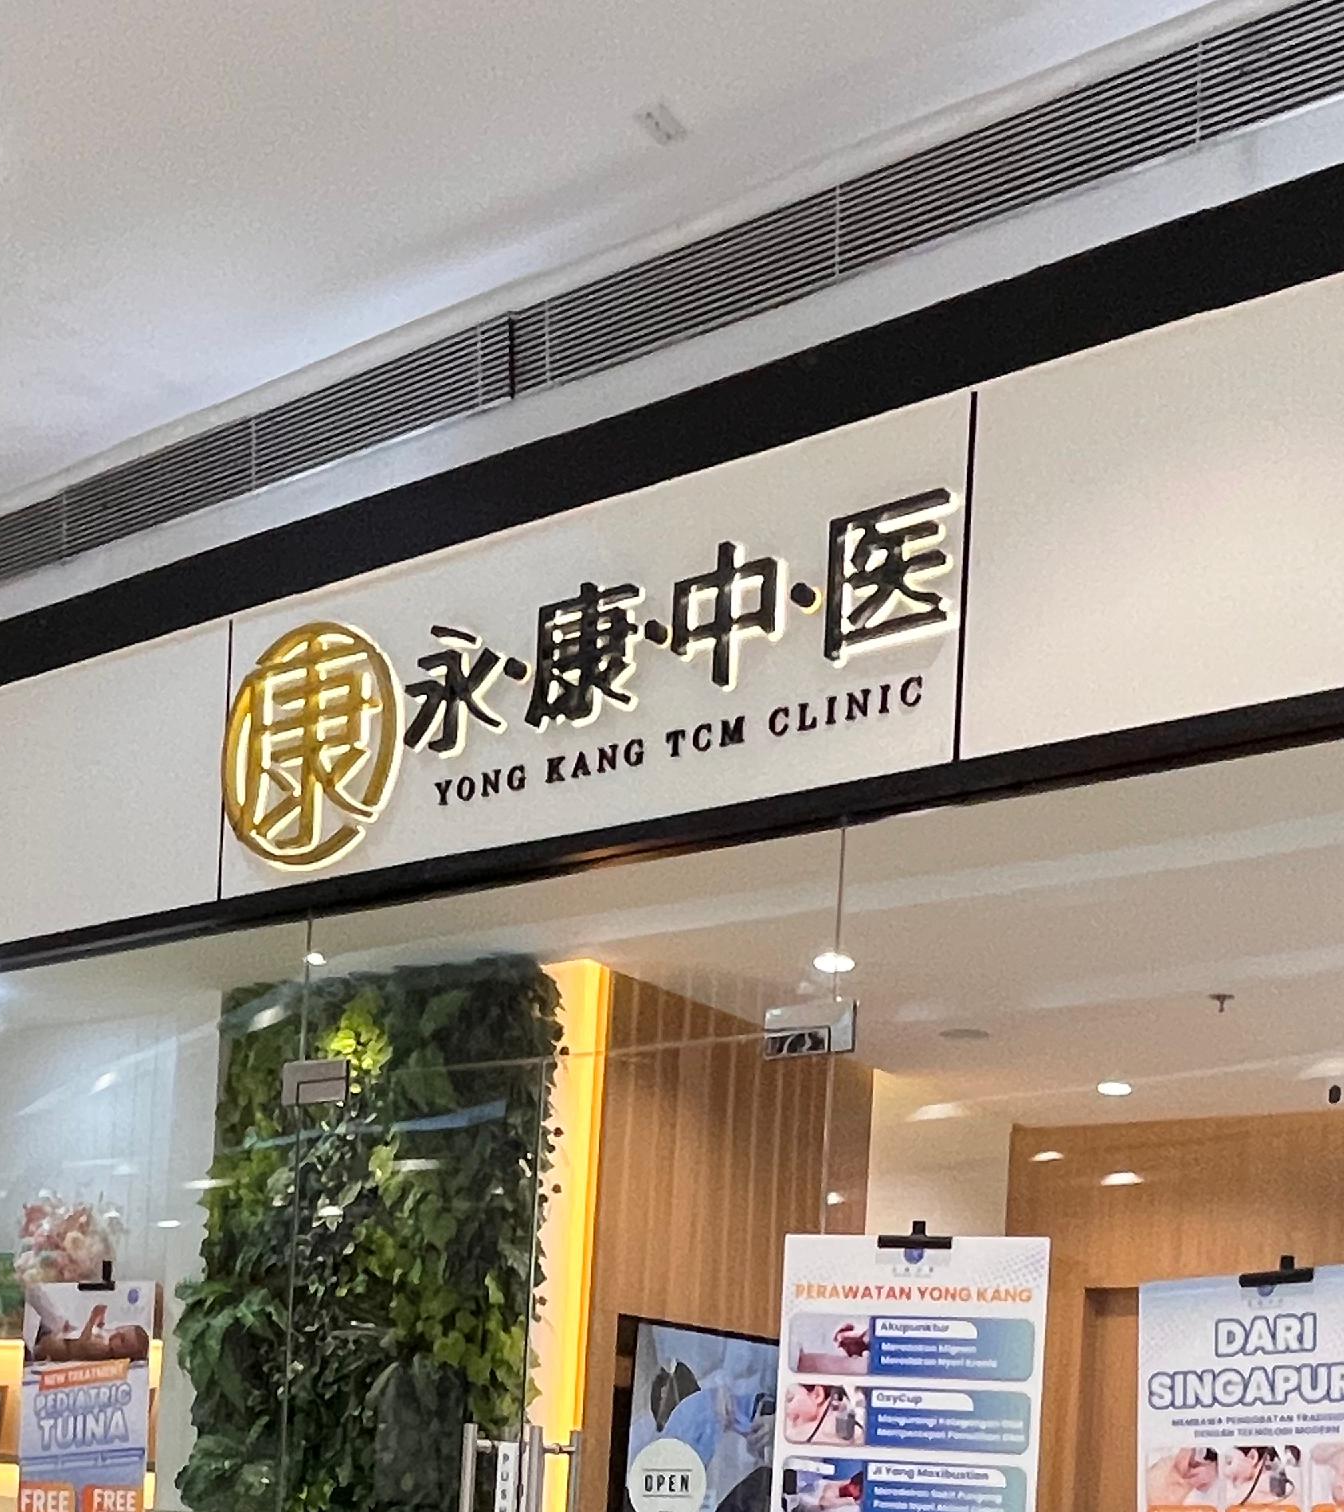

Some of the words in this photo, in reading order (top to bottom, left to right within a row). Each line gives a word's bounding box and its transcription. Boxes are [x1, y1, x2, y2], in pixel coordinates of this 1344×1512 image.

[435, 767, 526, 805] YONG
[545, 739, 645, 788] KANG
[667, 715, 746, 759] TCM
[768, 676, 925, 737] CLINIC
[795, 1283, 911, 1301] PERAWATAN
[917, 1286, 970, 1302] YONG
[976, 1287, 1033, 1303] KANG
[1215, 1313, 1317, 1358] DARI
[35, 1383, 132, 1416] PEDIATRIC
[40, 1408, 130, 1450] TUINA
[92, 1488, 137, 1512] FREE
[644, 1474, 690, 1493] OPEN
